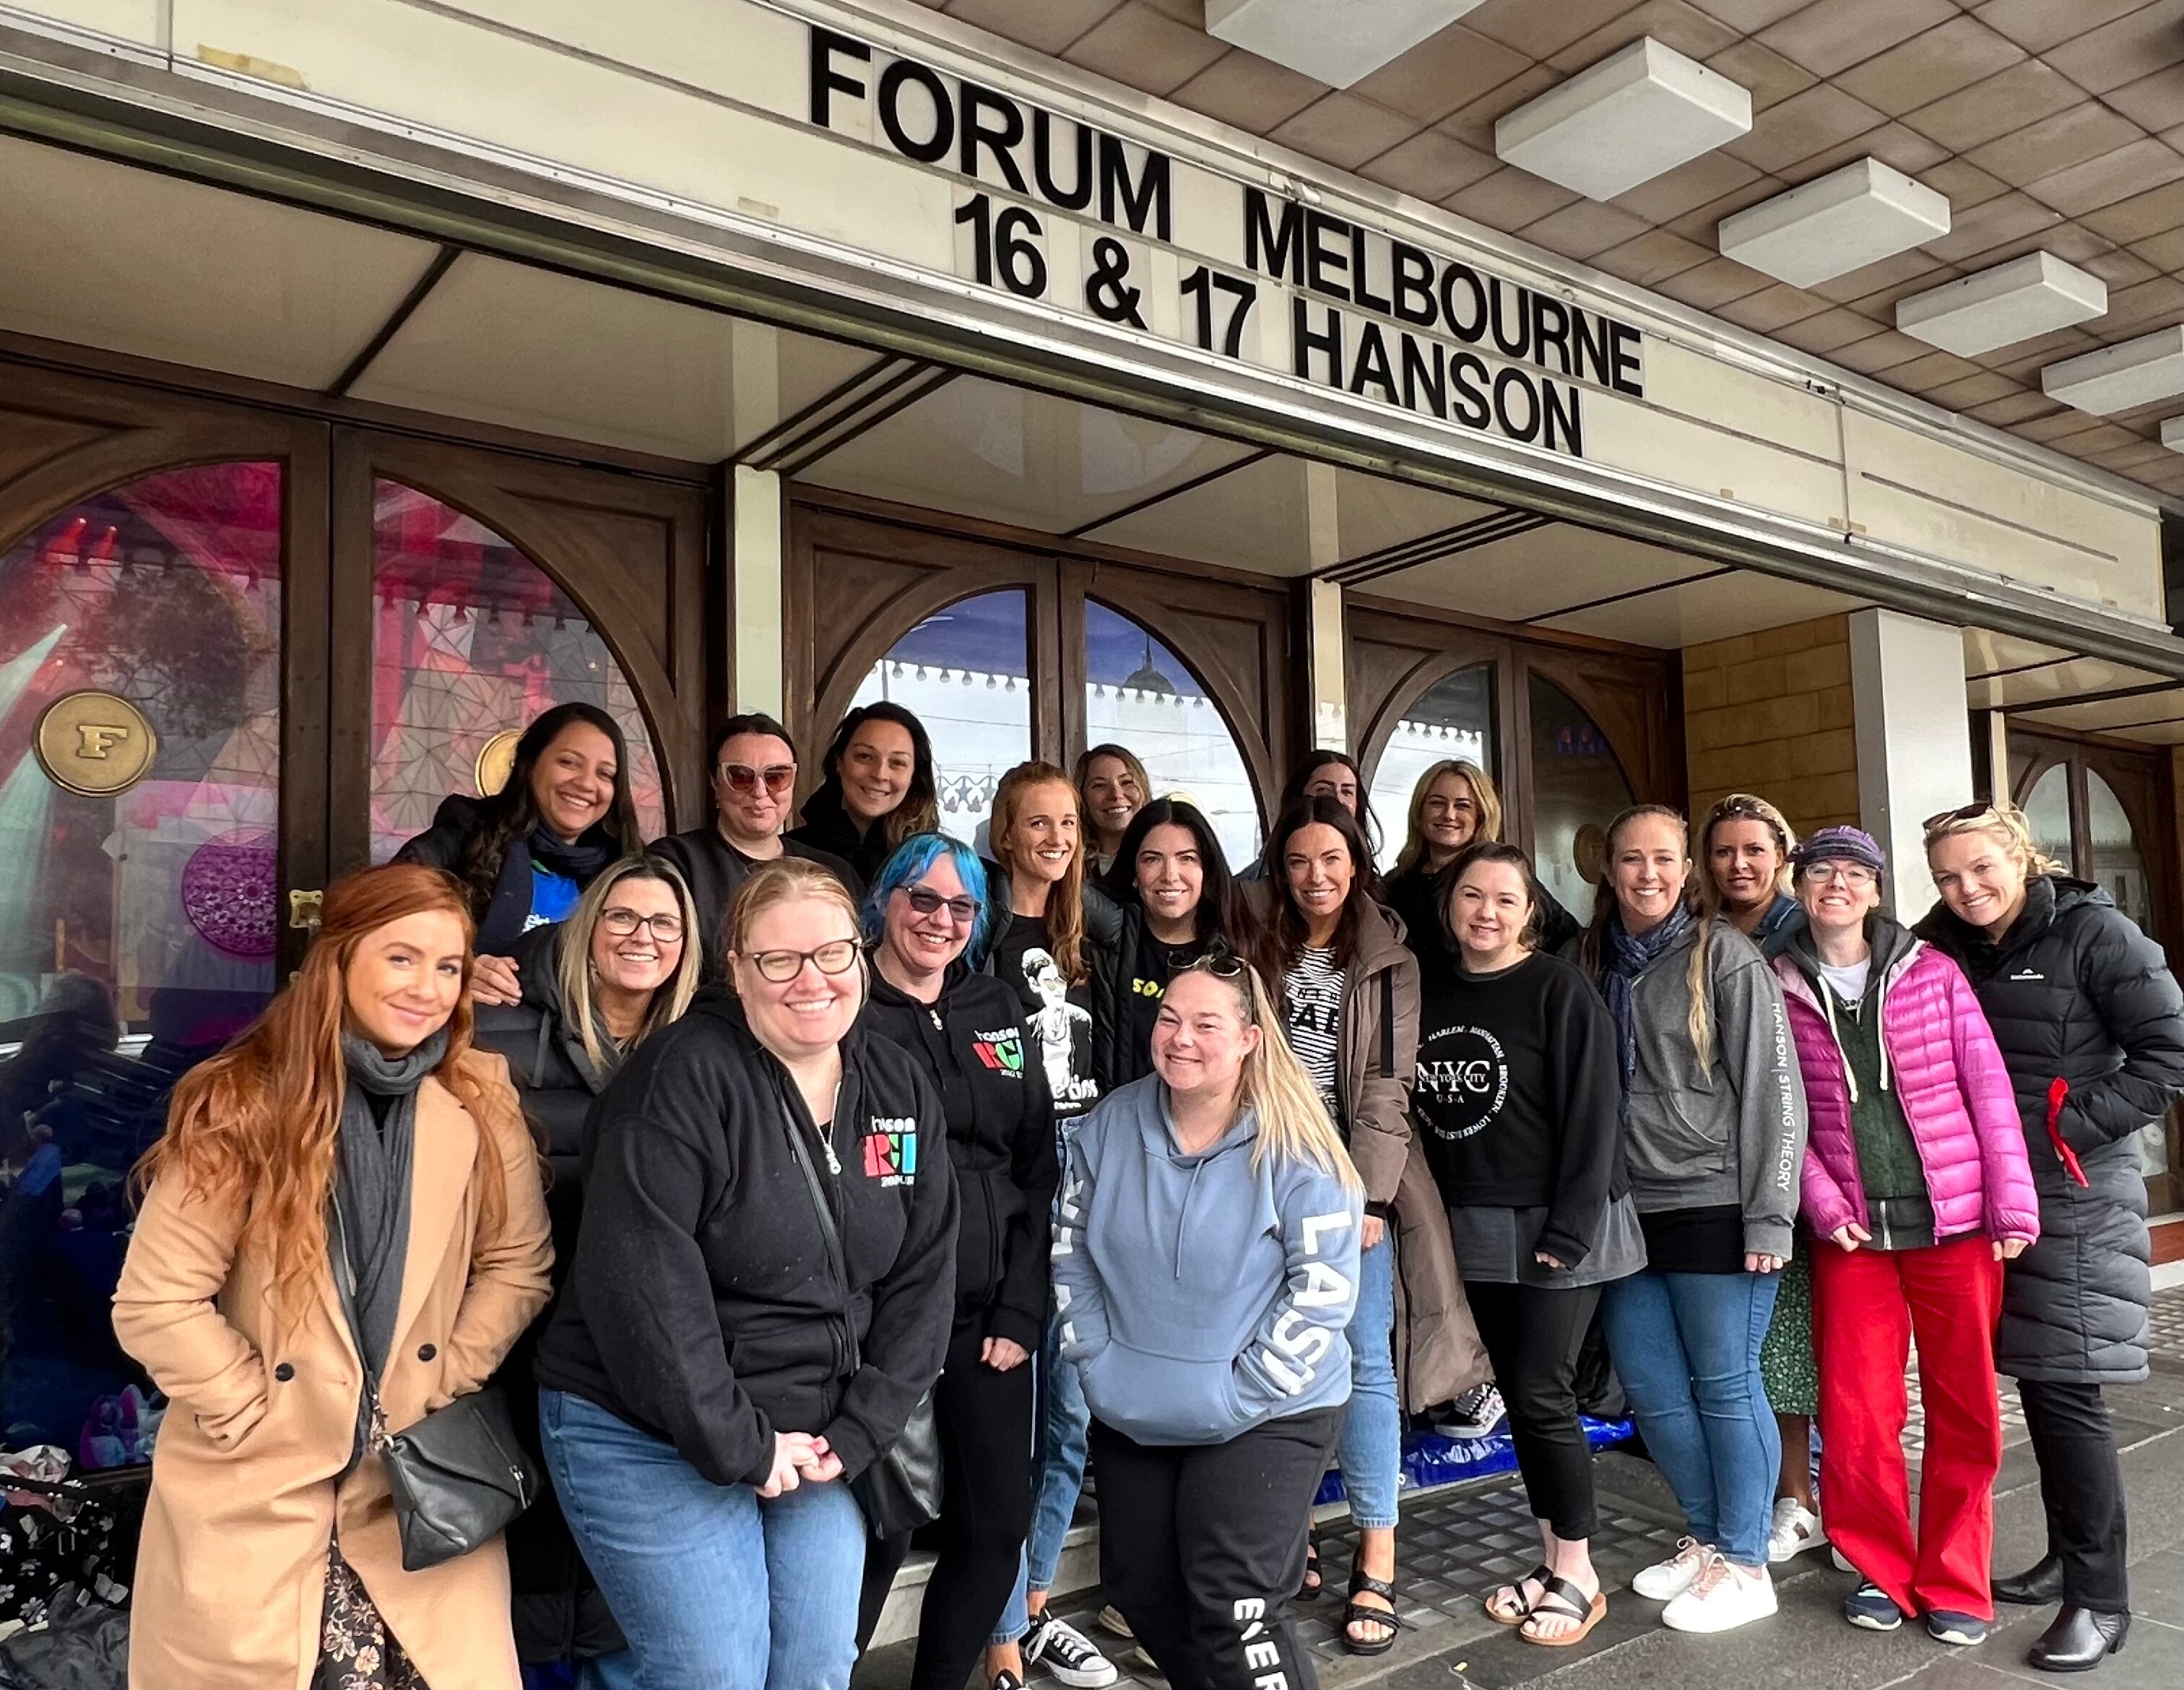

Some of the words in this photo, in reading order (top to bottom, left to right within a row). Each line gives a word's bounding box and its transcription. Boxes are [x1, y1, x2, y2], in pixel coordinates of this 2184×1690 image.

[809, 25, 1171, 243] FORUM
[1244, 186, 1644, 397] MELBOURNE
[954, 193, 1047, 299] 16
[1087, 237, 1149, 332] &
[1179, 265, 1255, 358] 17
[1295, 295, 1582, 457] HANSON
[76, 724, 128, 759] F
[1771, 1002, 1788, 1067] HANSON
[1416, 1060, 1491, 1093] NYC
[1778, 1075, 1795, 1127] STRING
[1777, 1131, 1795, 1192] THEORY
